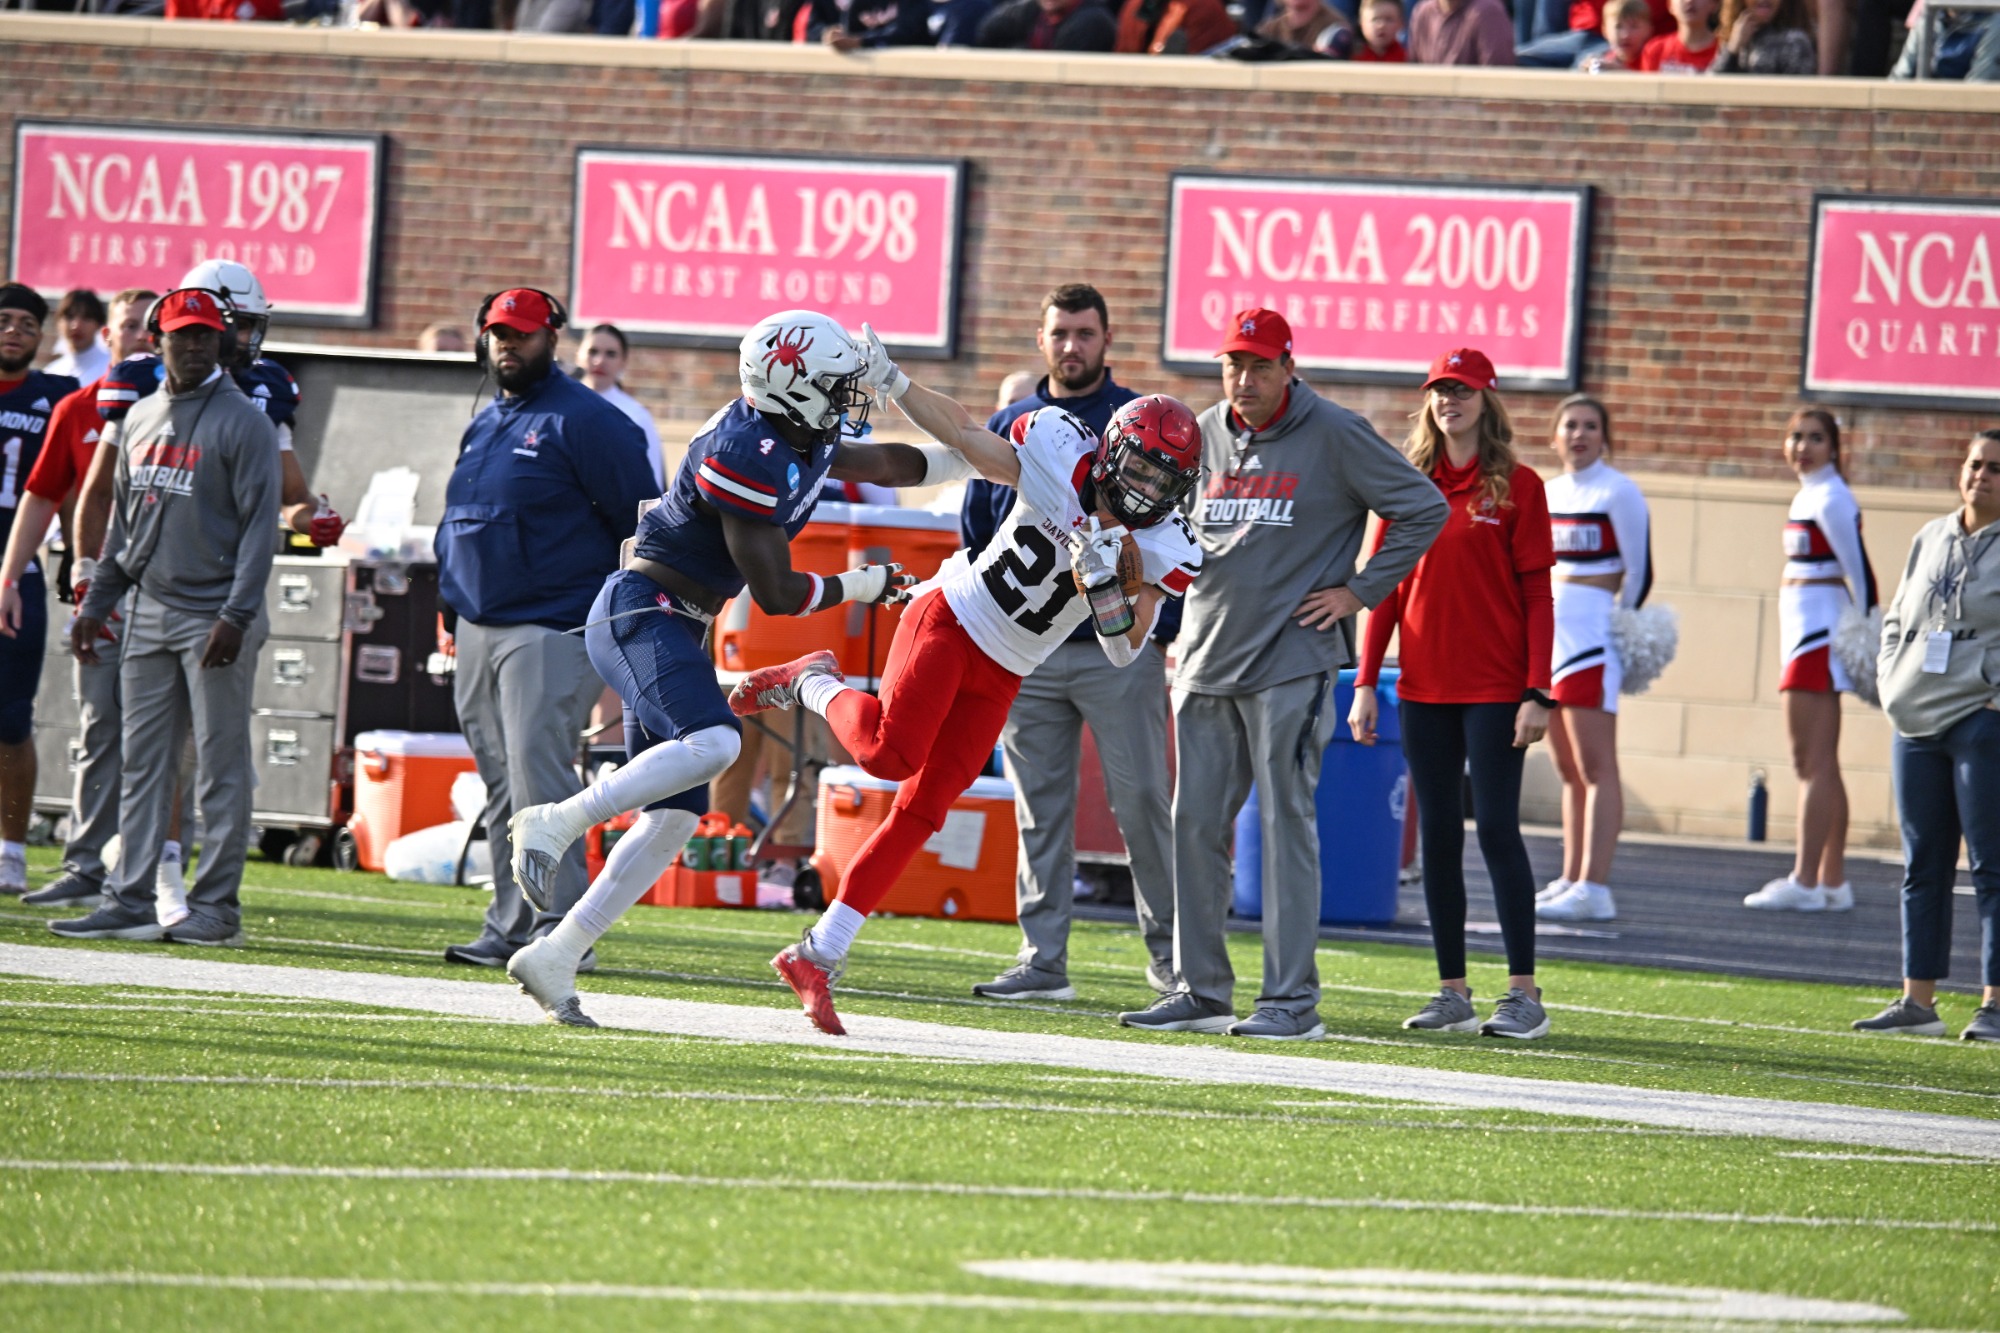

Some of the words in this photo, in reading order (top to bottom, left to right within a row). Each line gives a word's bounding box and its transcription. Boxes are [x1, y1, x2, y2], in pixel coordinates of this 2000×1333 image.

[47, 152, 206, 226] NCAA
[222, 161, 344, 234] 1987
[607, 179, 779, 256] NCAA
[792, 187, 917, 263] 1998
[68, 232, 171, 268] FIRST
[192, 239, 316, 275] ROUND
[1206, 207, 1389, 285] NCAA
[1402, 213, 1541, 292] 2000
[1852, 231, 2000, 309] NCA
[630, 261, 741, 298] FIRST
[759, 267, 892, 305] ROUND
[1846, 317, 2000, 359] QUART
[759, 438, 775, 455] 4
[1200, 498, 1294, 522] FOOTBALL
[982, 525, 1079, 636] 21
